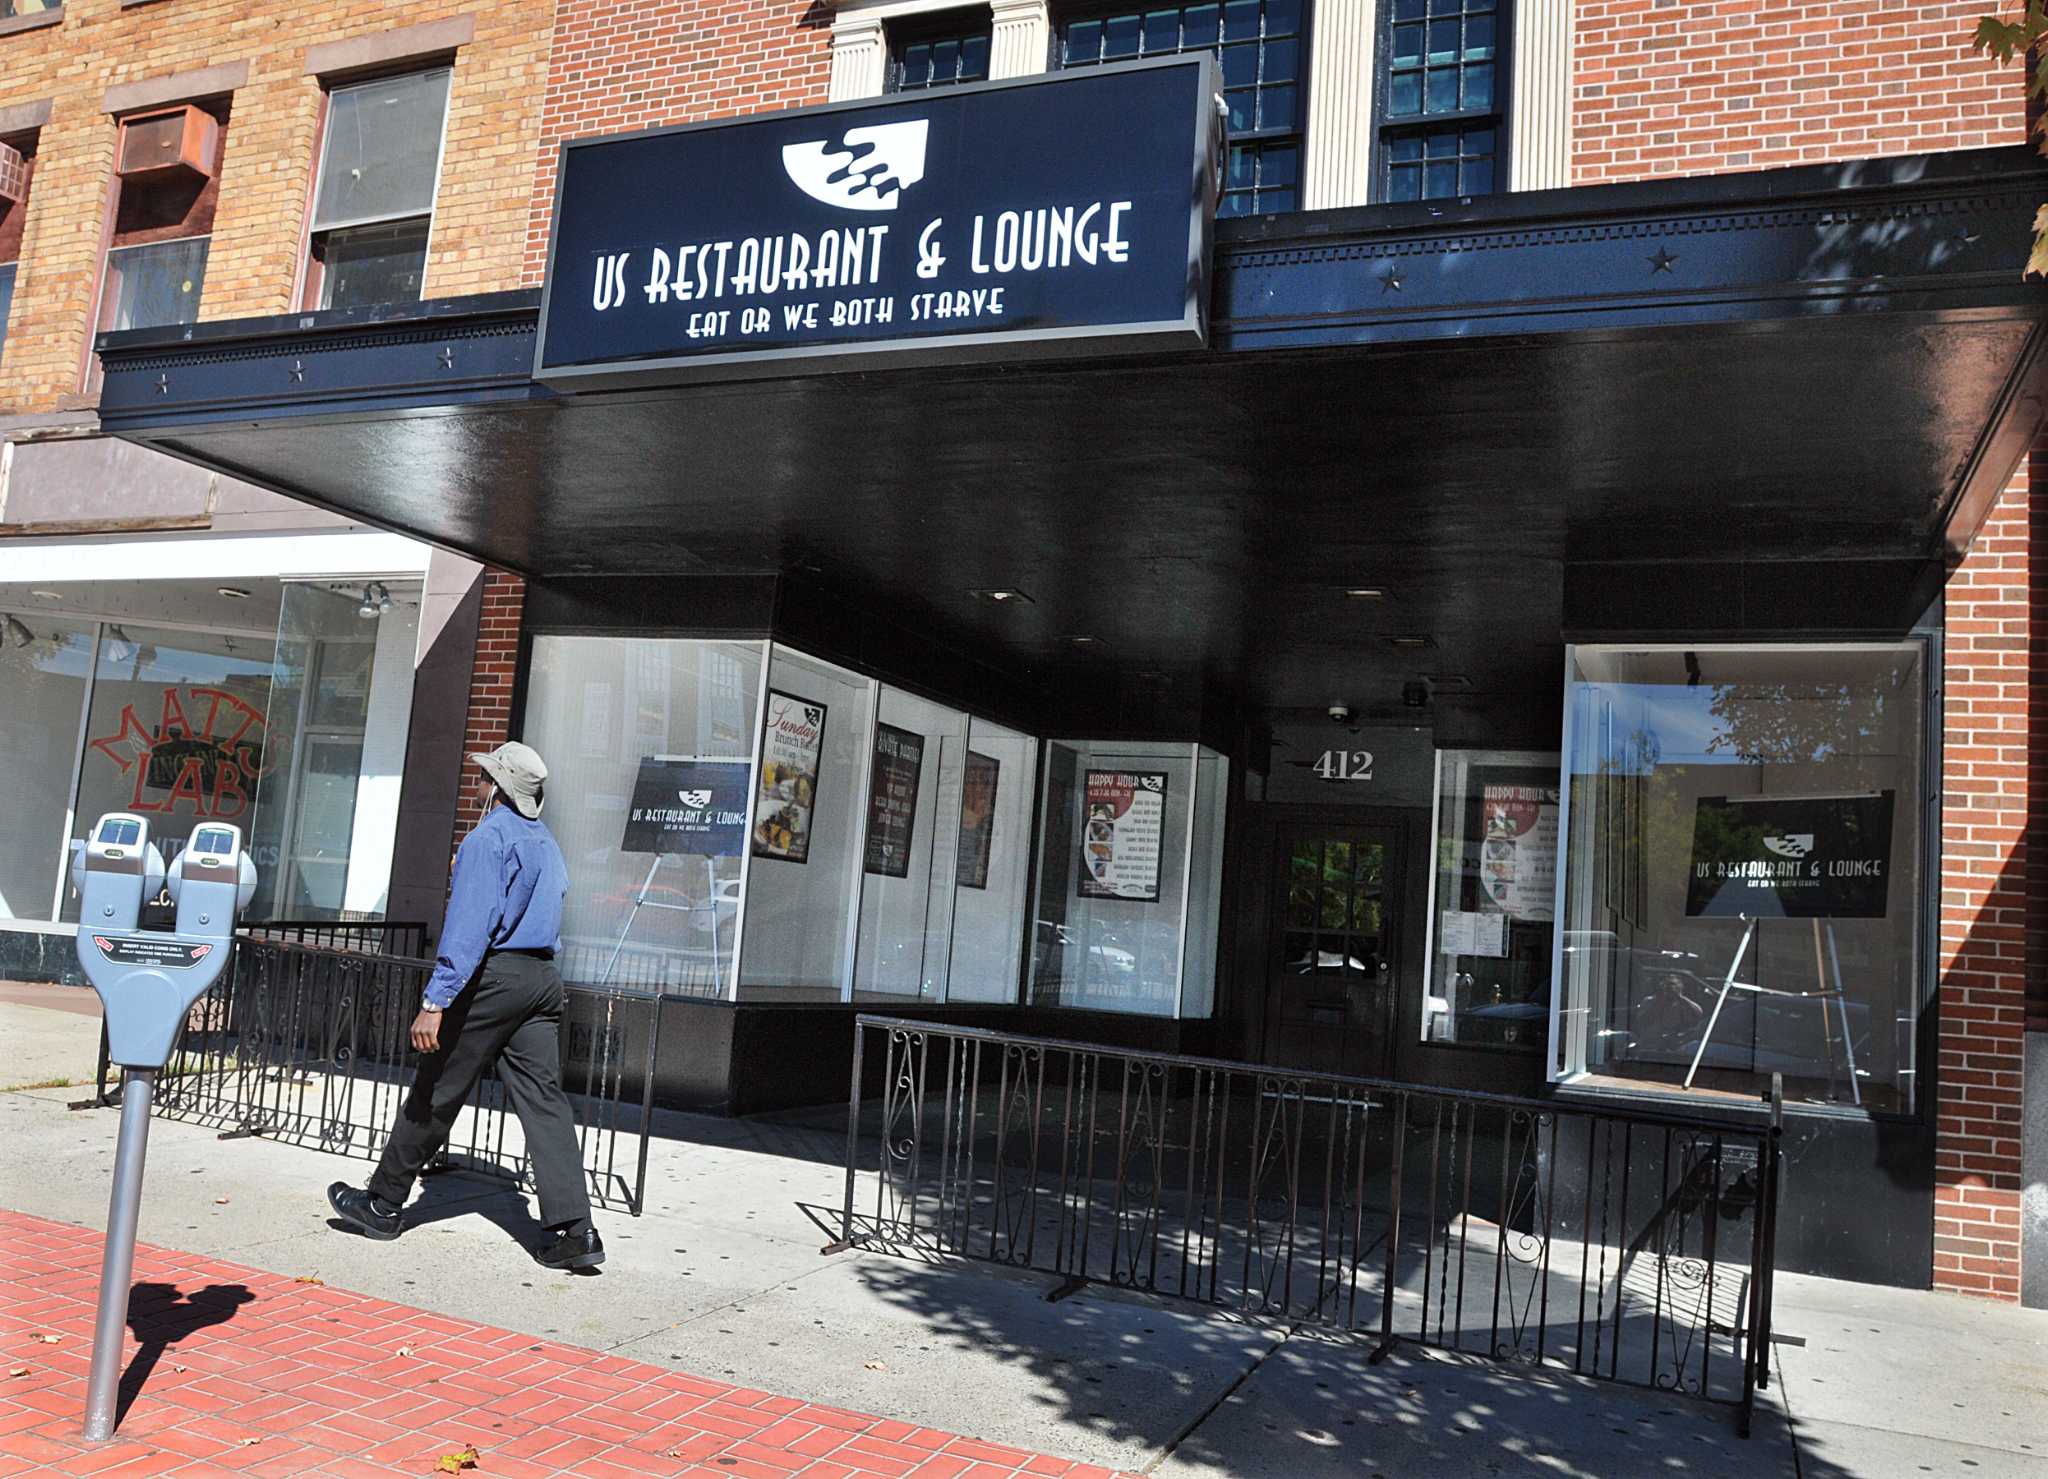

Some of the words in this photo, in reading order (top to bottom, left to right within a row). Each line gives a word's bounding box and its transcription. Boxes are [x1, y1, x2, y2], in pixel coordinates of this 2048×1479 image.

[593, 252, 630, 311] US
[643, 225, 889, 304] RESTAURANT
[917, 218, 946, 280] &
[971, 201, 1132, 275] LOUNGE
[685, 310, 730, 338] EAT
[740, 307, 770, 334] OR
[784, 302, 819, 331] WE
[829, 297, 894, 328] BOTH
[910, 288, 1005, 321] STARVE
[767, 697, 819, 744] Sunday
[1312, 750, 1374, 780] 412
[128, 752, 249, 818] LAB
[1088, 773, 1114, 787] HAPPY
[1116, 774, 1140, 788] HOUR
[1485, 785, 1514, 800] HAPPY
[1518, 787, 1545, 801] HOUR
[632, 808, 643, 821] US
[645, 809, 702, 823] RESTAURANT
[1696, 862, 1710, 878] US
[1716, 861, 1802, 878] RESTAURANT
[1810, 861, 1821, 877] &
[1828, 860, 1882, 877] LOUNGE
